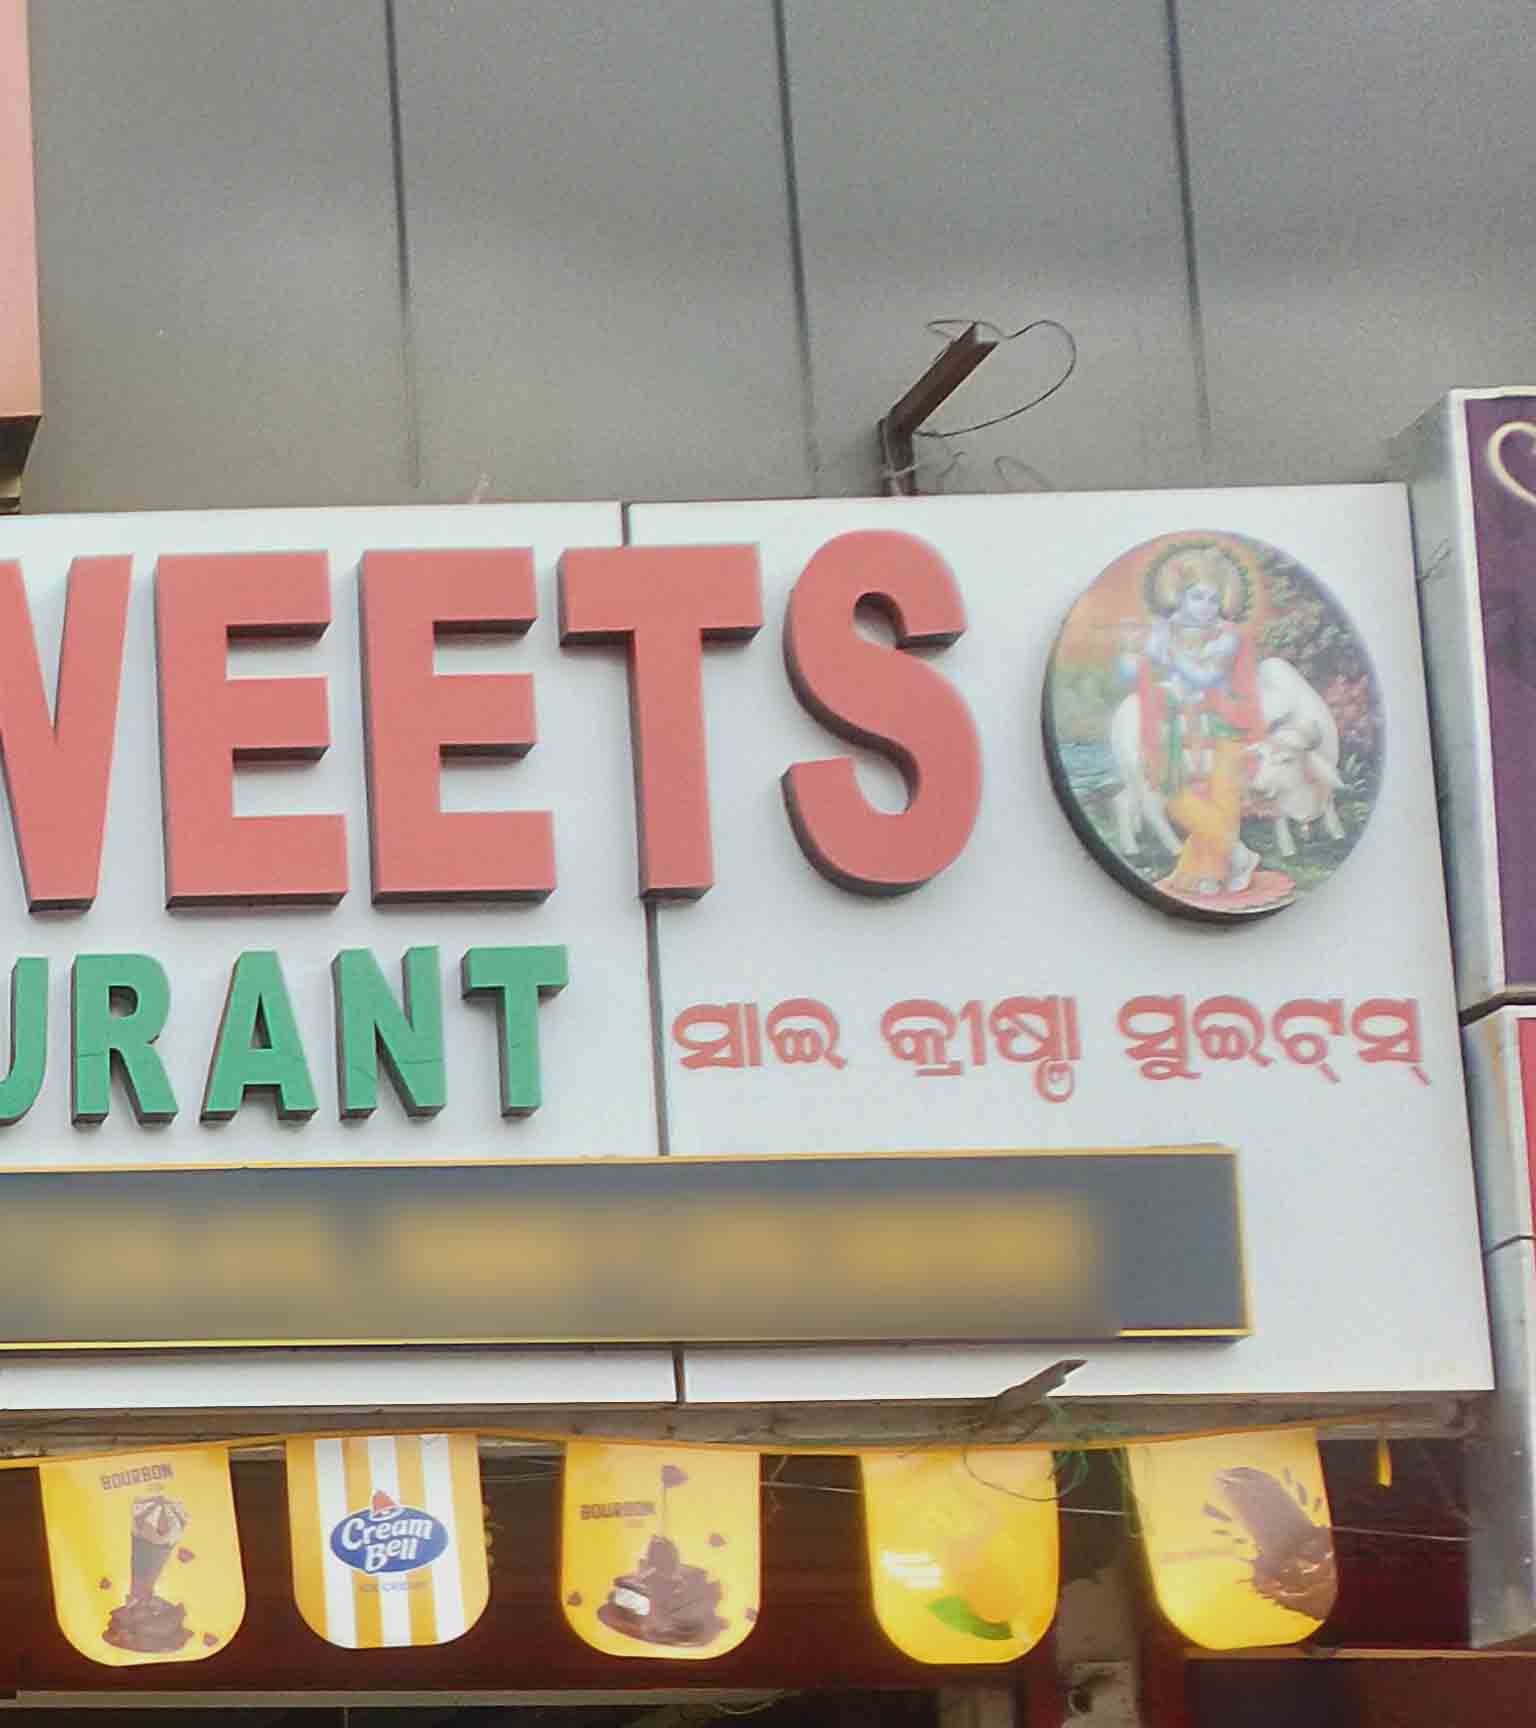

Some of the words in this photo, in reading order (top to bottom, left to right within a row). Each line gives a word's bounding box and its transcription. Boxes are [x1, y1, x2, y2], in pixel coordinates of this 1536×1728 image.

[672, 997, 846, 1071] ସାଇ
[341, 1517, 433, 1551] Cream
[364, 1537, 418, 1572] Bell
